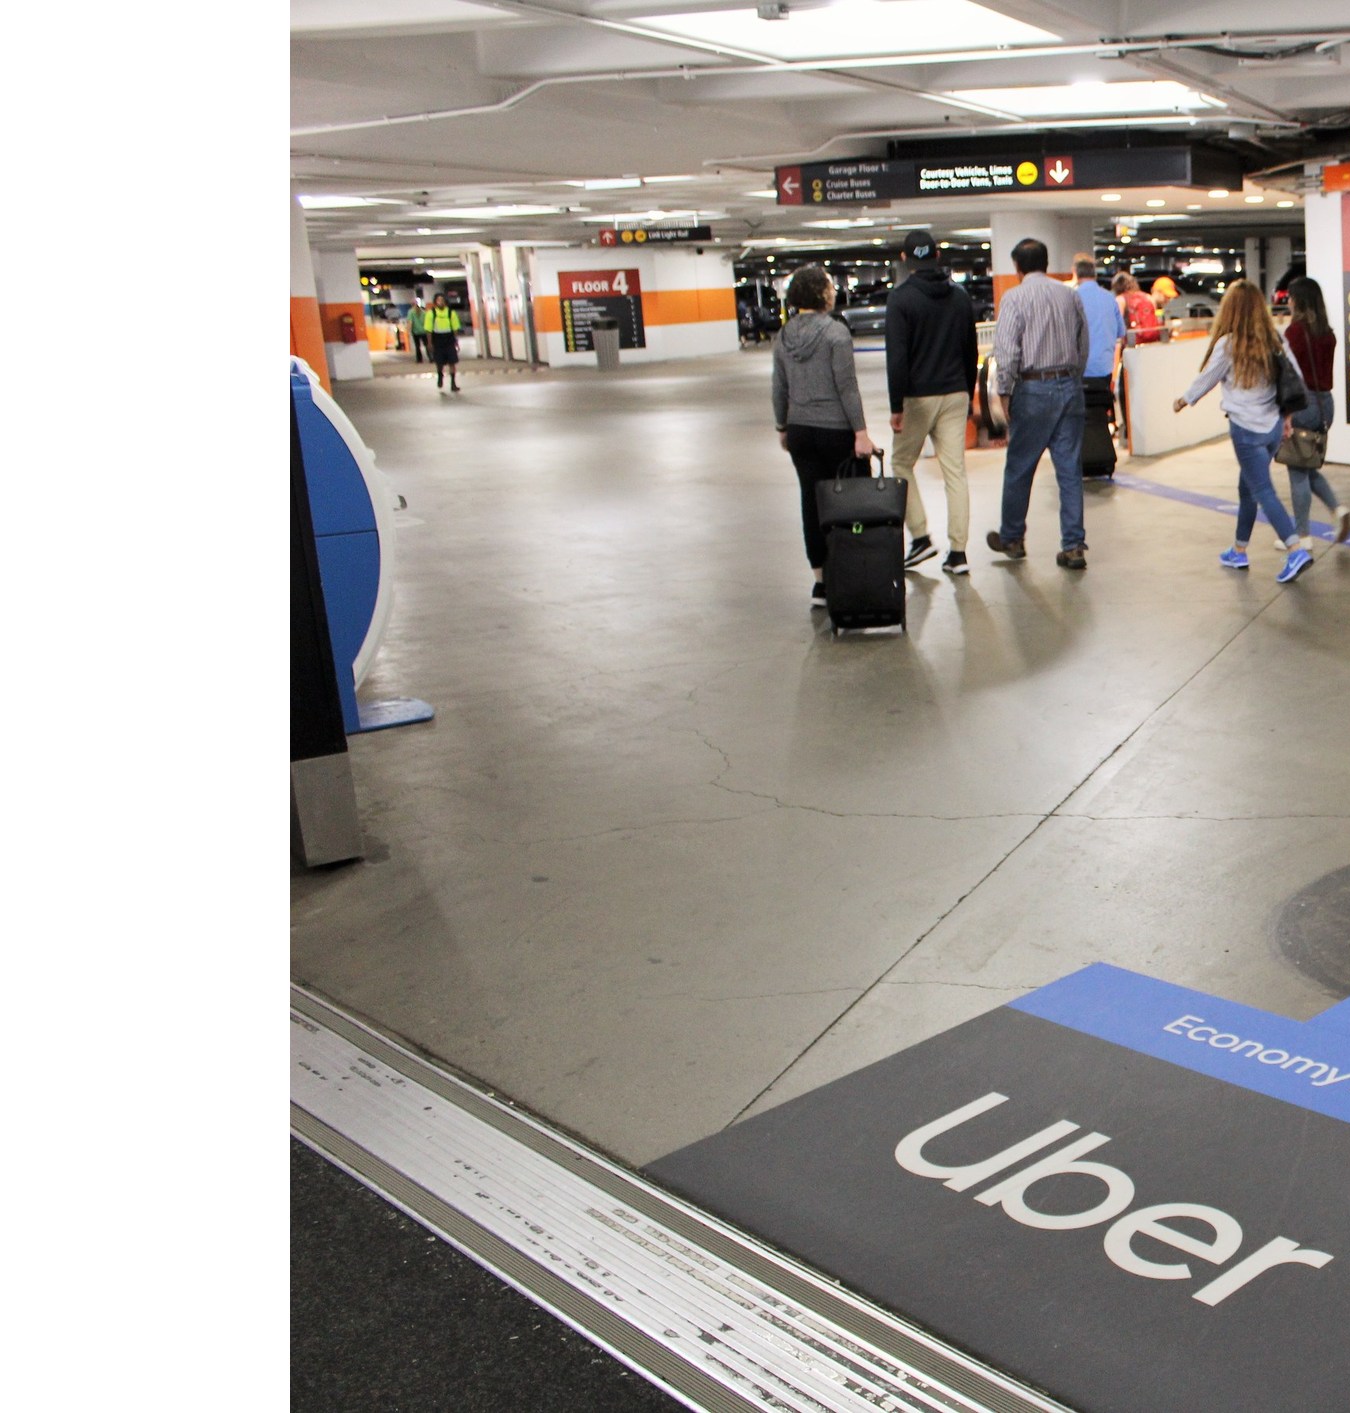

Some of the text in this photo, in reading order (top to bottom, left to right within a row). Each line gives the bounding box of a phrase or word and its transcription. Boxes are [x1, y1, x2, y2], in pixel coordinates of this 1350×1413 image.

[828, 165, 857, 175] Garage
[858, 163, 879, 173] Floor
[920, 168, 954, 179] Courtesy
[989, 165, 1013, 176] Limos
[826, 179, 871, 189] Cruise Buses
[993, 175, 1013, 186] Taxis
[826, 190, 876, 200] Charter Buses
[648, 229, 689, 240] Link Light Rail
[572, 270, 629, 295] FLOOR 4
[894, 1091, 1334, 1307] Uber
